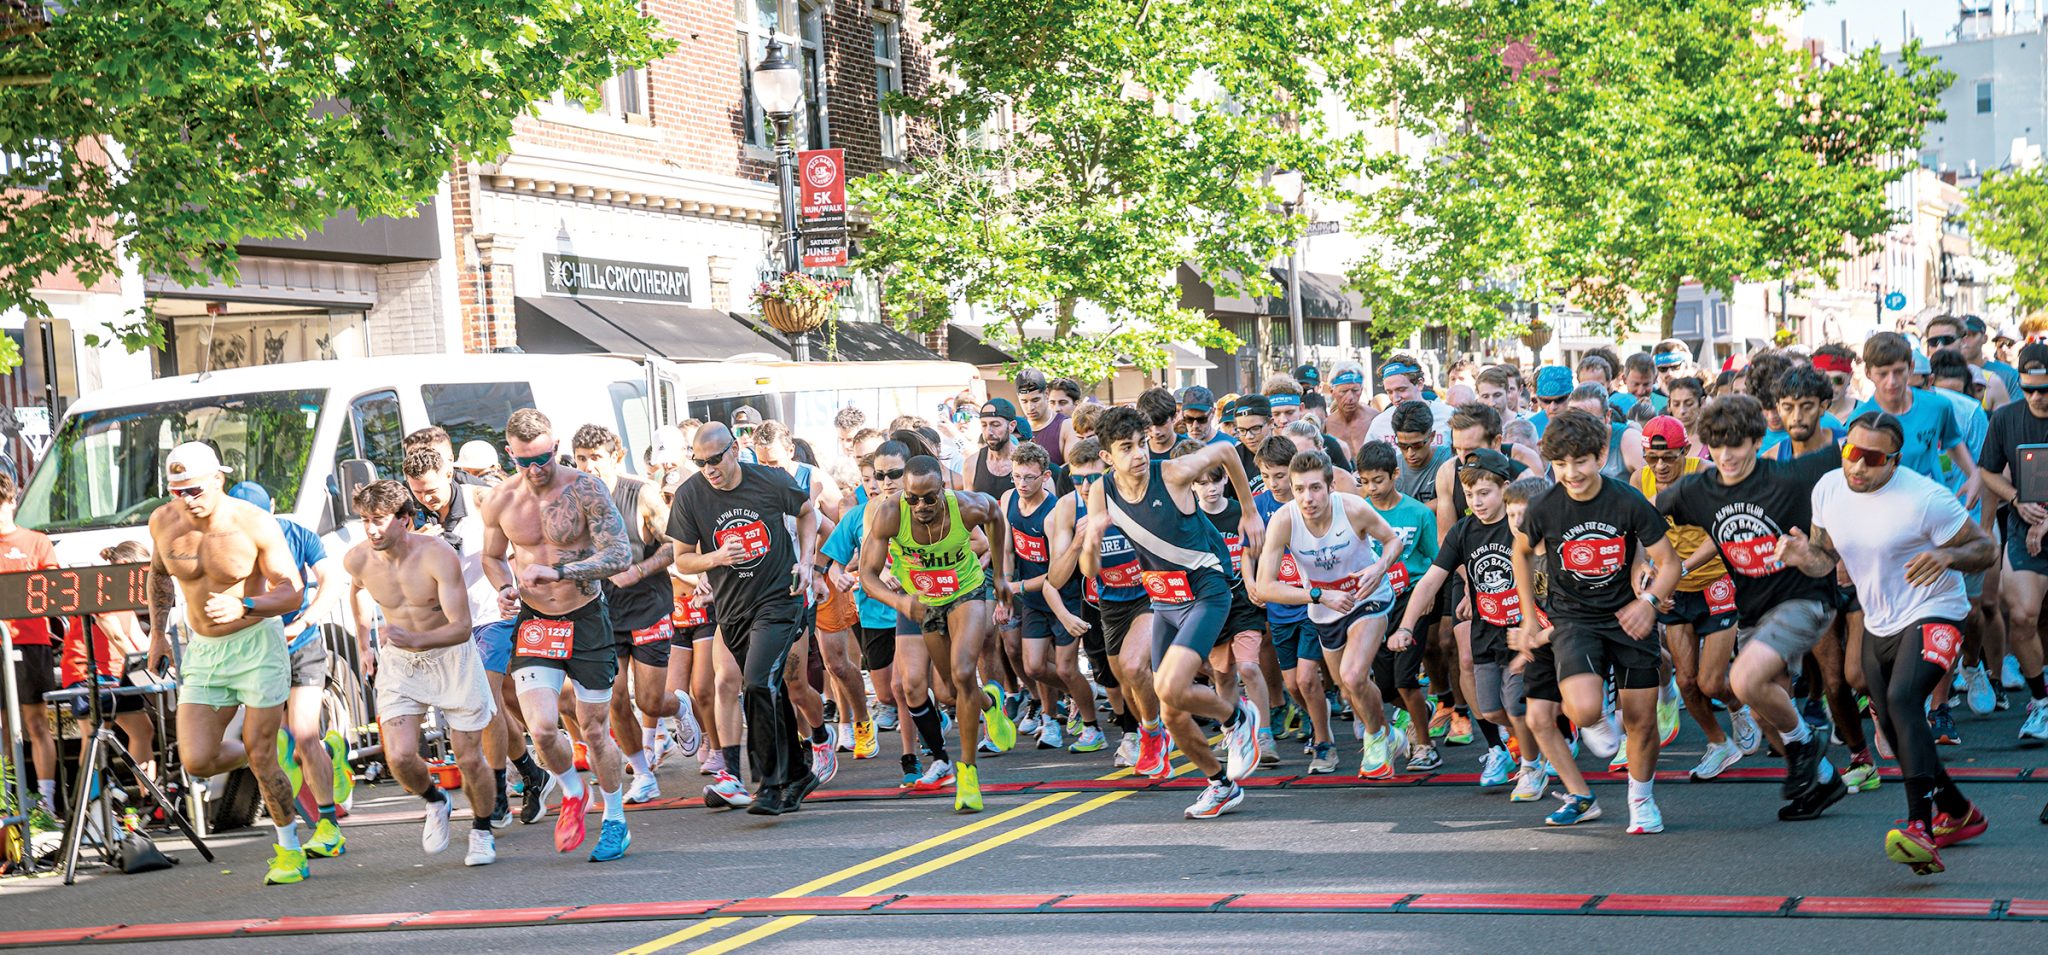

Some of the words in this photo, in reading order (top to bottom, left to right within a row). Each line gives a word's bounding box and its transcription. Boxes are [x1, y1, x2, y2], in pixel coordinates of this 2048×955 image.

[813, 191, 832, 205] 5K
[804, 204, 842, 214] RUN/WALK
[810, 238, 840, 246] SATURDAY
[805, 247, 830, 257] JUNE
[561, 261, 604, 289] CHILL
[605, 265, 689, 296] CRYOTHERAPY
[716, 510, 733, 526] ALPHA
[733, 508, 743, 516] FIT
[743, 509, 760, 520] CLUB
[1715, 504, 1735, 522] ALPHA
[1734, 502, 1745, 513] FIT
[1746, 503, 1764, 518] CLUB
[744, 528, 760, 539] 257
[1562, 524, 1585, 541] ALPHA
[1584, 521, 1598, 530] FIT
[1597, 522, 1617, 535] CLUB
[1739, 519, 1767, 538] BANK
[1470, 545, 1489, 560] ALPHA
[1489, 543, 1499, 551] FIT
[1599, 544, 1620, 555] 882
[1753, 541, 1774, 555] 942
[1125, 563, 1141, 574] 931
[1477, 560, 1490, 575] RED
[1491, 558, 1512, 573] BANK
[936, 576, 954, 584] 658
[1484, 570, 1504, 583] 5K
[1502, 595, 1519, 607] 468
[548, 627, 571, 638] 1239
